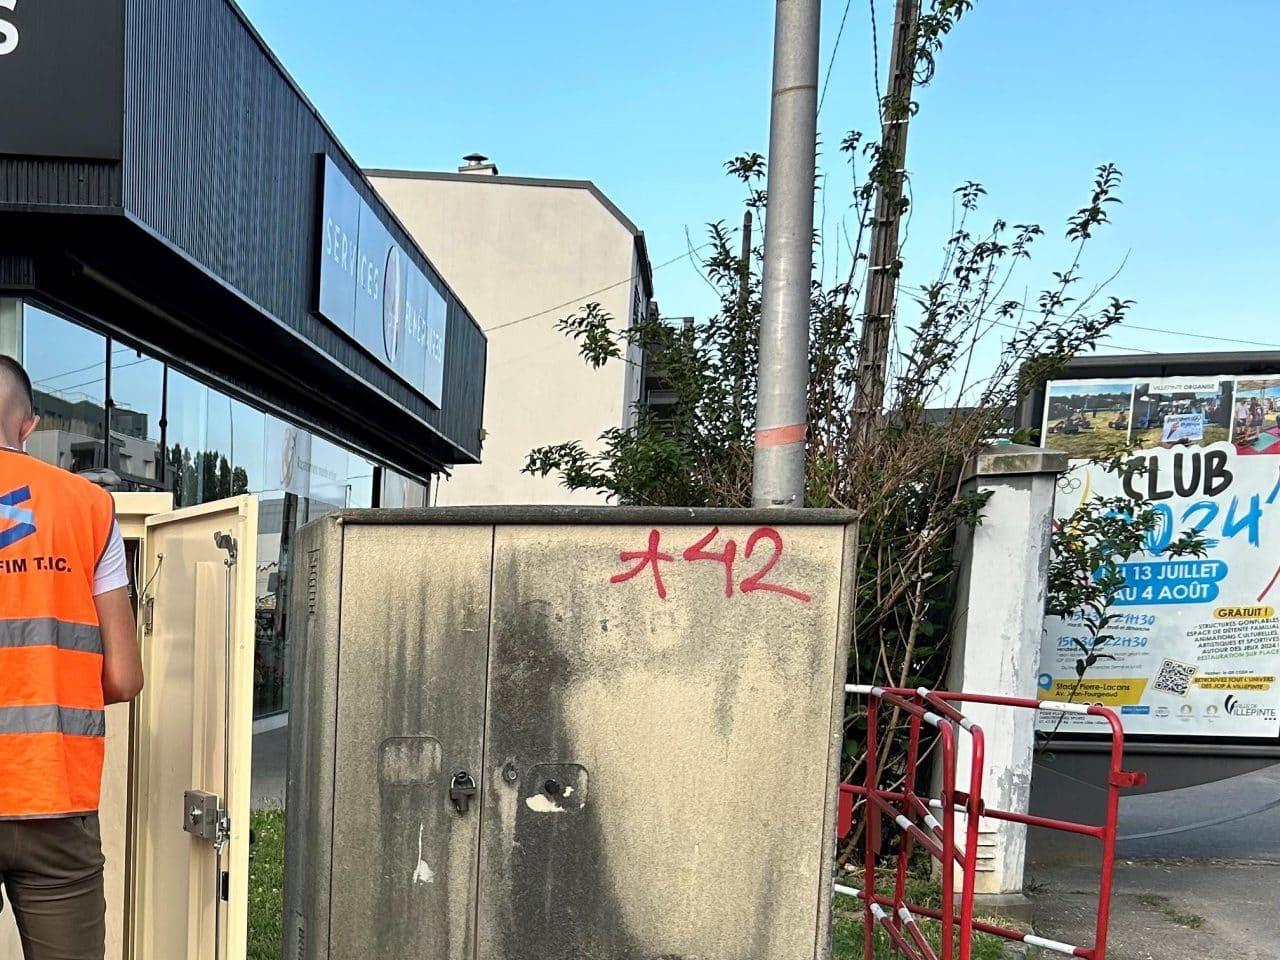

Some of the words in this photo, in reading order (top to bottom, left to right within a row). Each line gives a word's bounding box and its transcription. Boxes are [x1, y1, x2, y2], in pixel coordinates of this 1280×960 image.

[1122, 450, 1234, 501] CLUB
[1133, 566, 1152, 580] 13
[1156, 563, 1219, 580] JUILLET
[1113, 587, 1137, 601] AU
[1141, 586, 1153, 600] 4
[1158, 581, 1210, 600] AOÛT
[1218, 608, 1261, 617] GRATUIT
